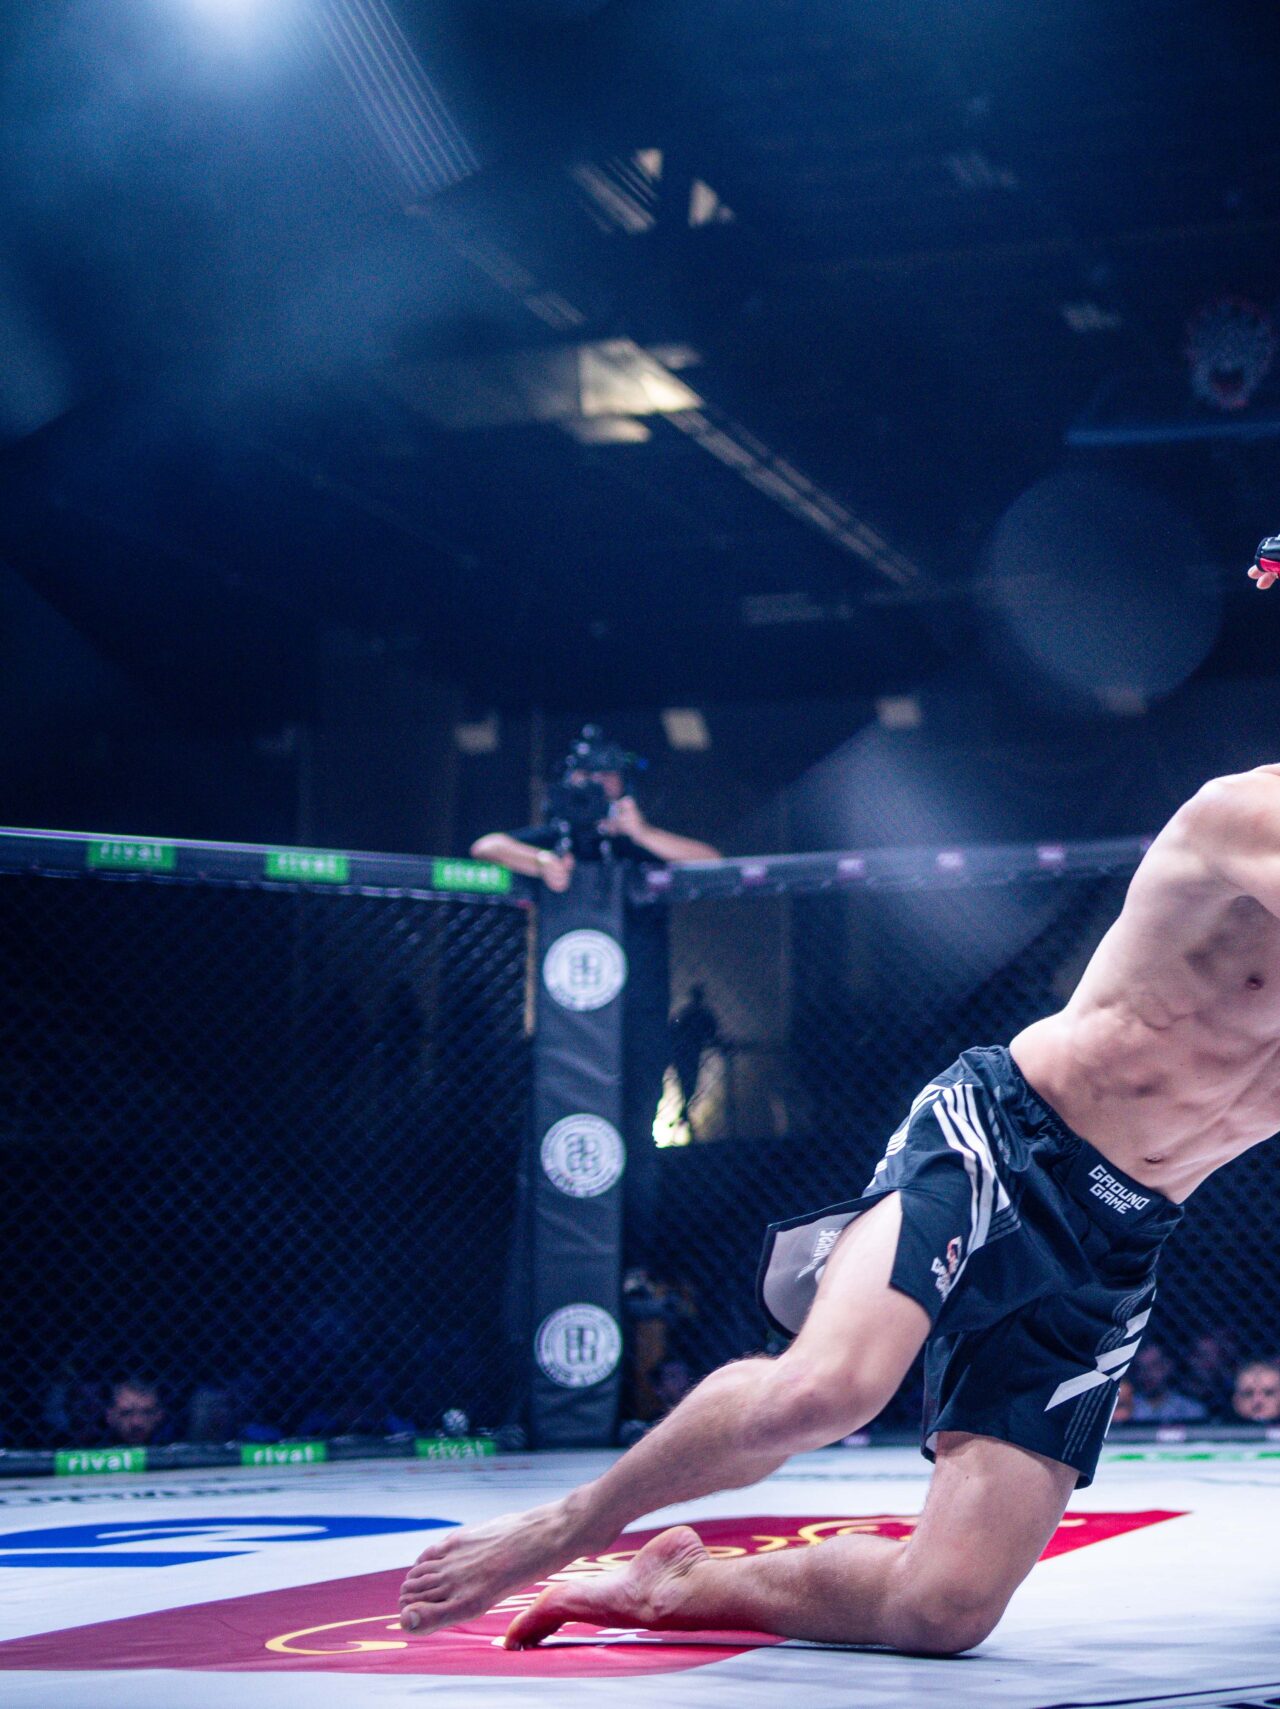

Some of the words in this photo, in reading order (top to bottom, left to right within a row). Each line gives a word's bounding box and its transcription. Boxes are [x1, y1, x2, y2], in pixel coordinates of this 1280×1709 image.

[1088, 1164, 1150, 1210] GROUND
[1089, 1182, 1132, 1214] GAME
[67, 1451, 133, 1471] rival
[253, 1446, 314, 1464] rival
